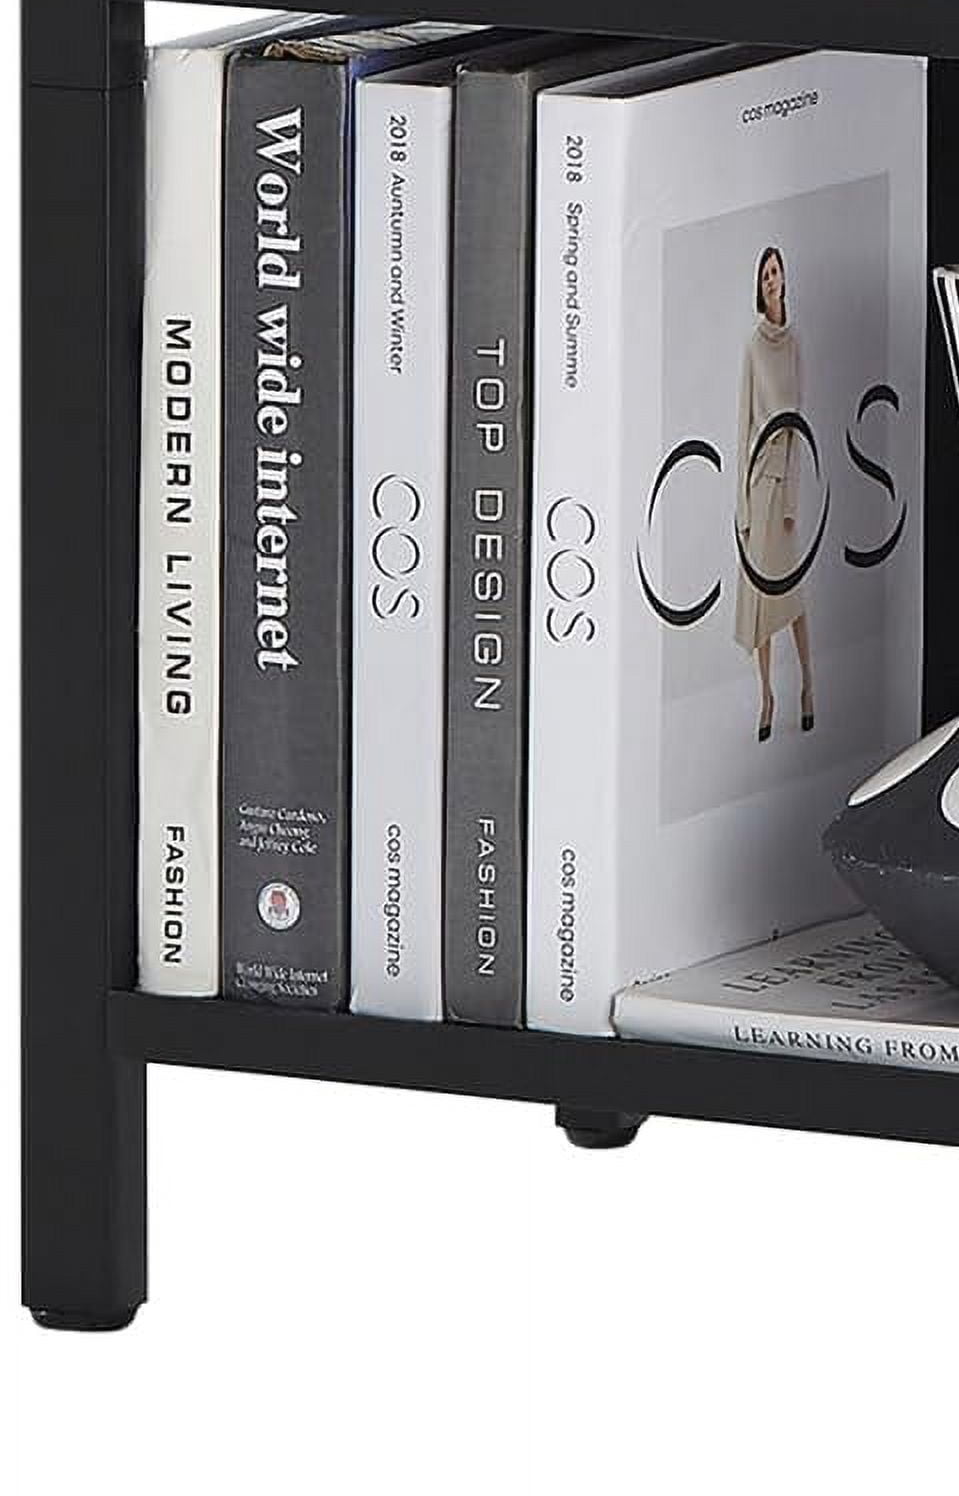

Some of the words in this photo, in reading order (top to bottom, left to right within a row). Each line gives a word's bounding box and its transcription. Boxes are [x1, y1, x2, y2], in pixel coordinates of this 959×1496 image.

[389, 114, 407, 162] 2018
[565, 134, 584, 183] 2018
[742, 106, 762, 124] cos
[764, 91, 819, 118] magazine
[255, 106, 303, 291] World
[389, 172, 407, 262] Auntumn
[562, 201, 584, 267] Spring
[389, 264, 407, 305] and
[564, 269, 583, 310] and
[255, 304, 303, 437] wide
[388, 307, 407, 375] Winter
[474, 337, 506, 453] TOP
[165, 317, 193, 524] MODERN
[254, 447, 303, 672] internet
[371, 473, 421, 620] COS
[635, 383, 908, 628] COS
[473, 489, 505, 711] DESIGN
[546, 495, 596, 644] COS
[165, 553, 193, 717] LIVING
[163, 824, 185, 965] FASHION
[386, 823, 402, 864] cos
[475, 816, 498, 977] FASHION
[560, 848, 577, 889] cos
[383, 868, 405, 979] magazine
[556, 891, 578, 1003] magazine
[734, 1025, 873, 1056] LEARNING
[885, 1038, 959, 1064] FROM
